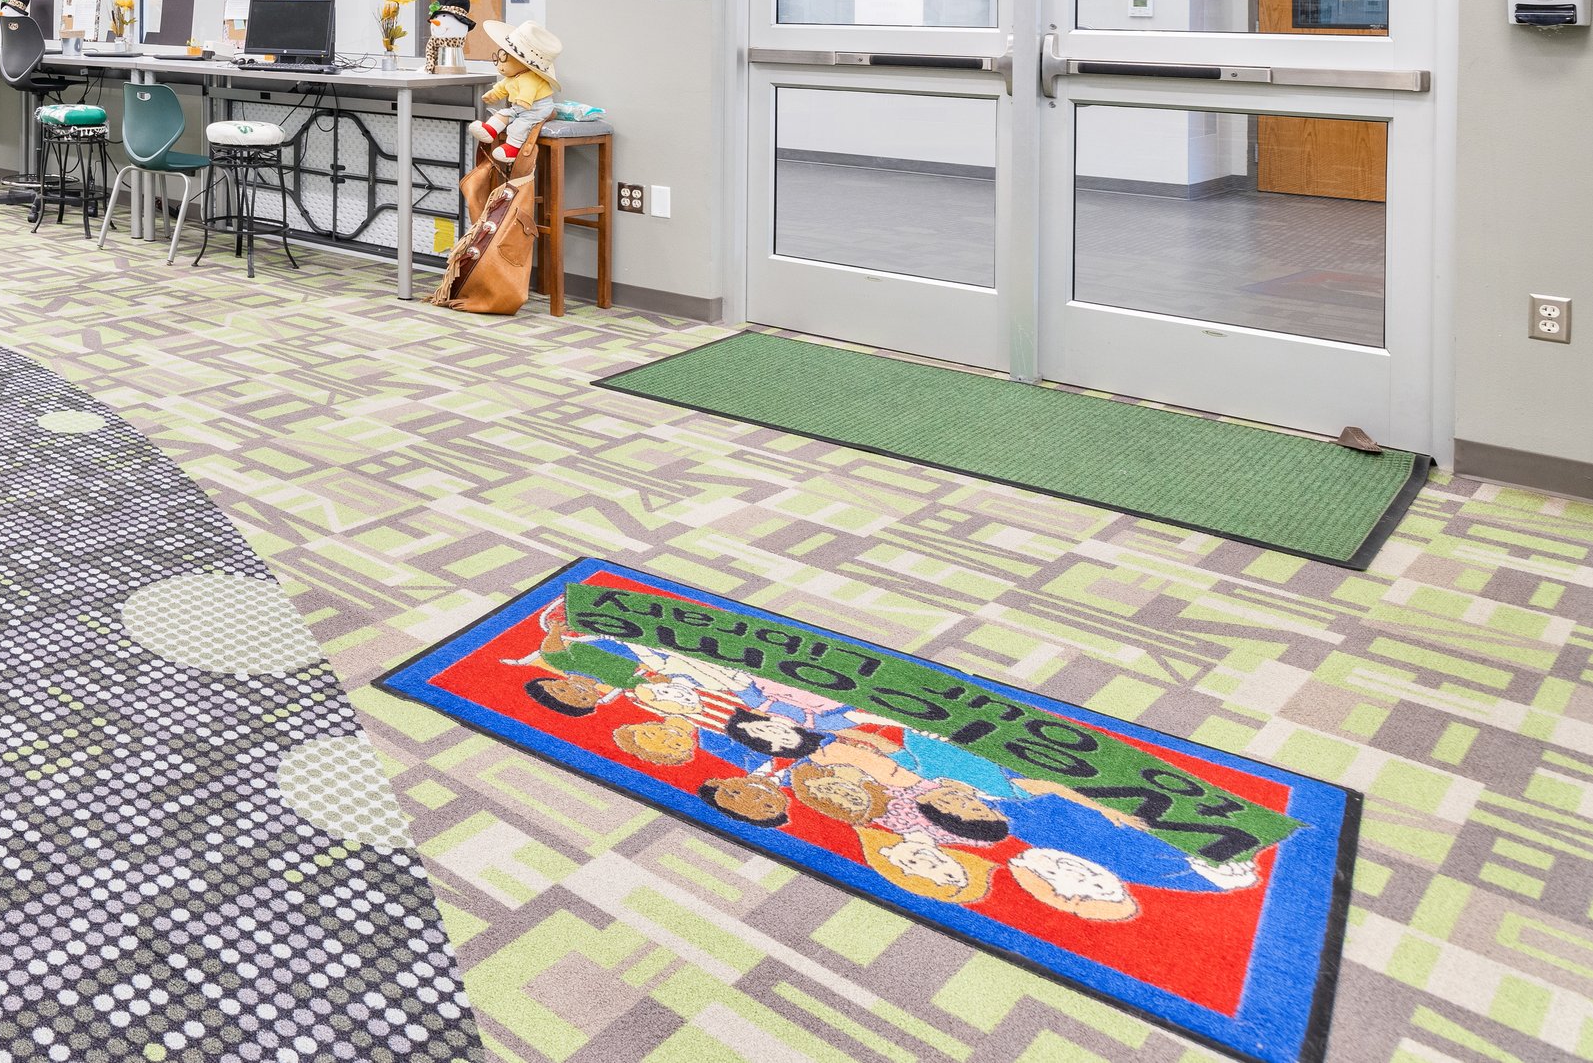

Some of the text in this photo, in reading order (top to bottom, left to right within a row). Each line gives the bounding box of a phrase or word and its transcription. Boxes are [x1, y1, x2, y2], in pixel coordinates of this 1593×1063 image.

[593, 590, 881, 677] Library
[575, 612, 1261, 863] Welcome
[1139, 767, 1245, 819] to
